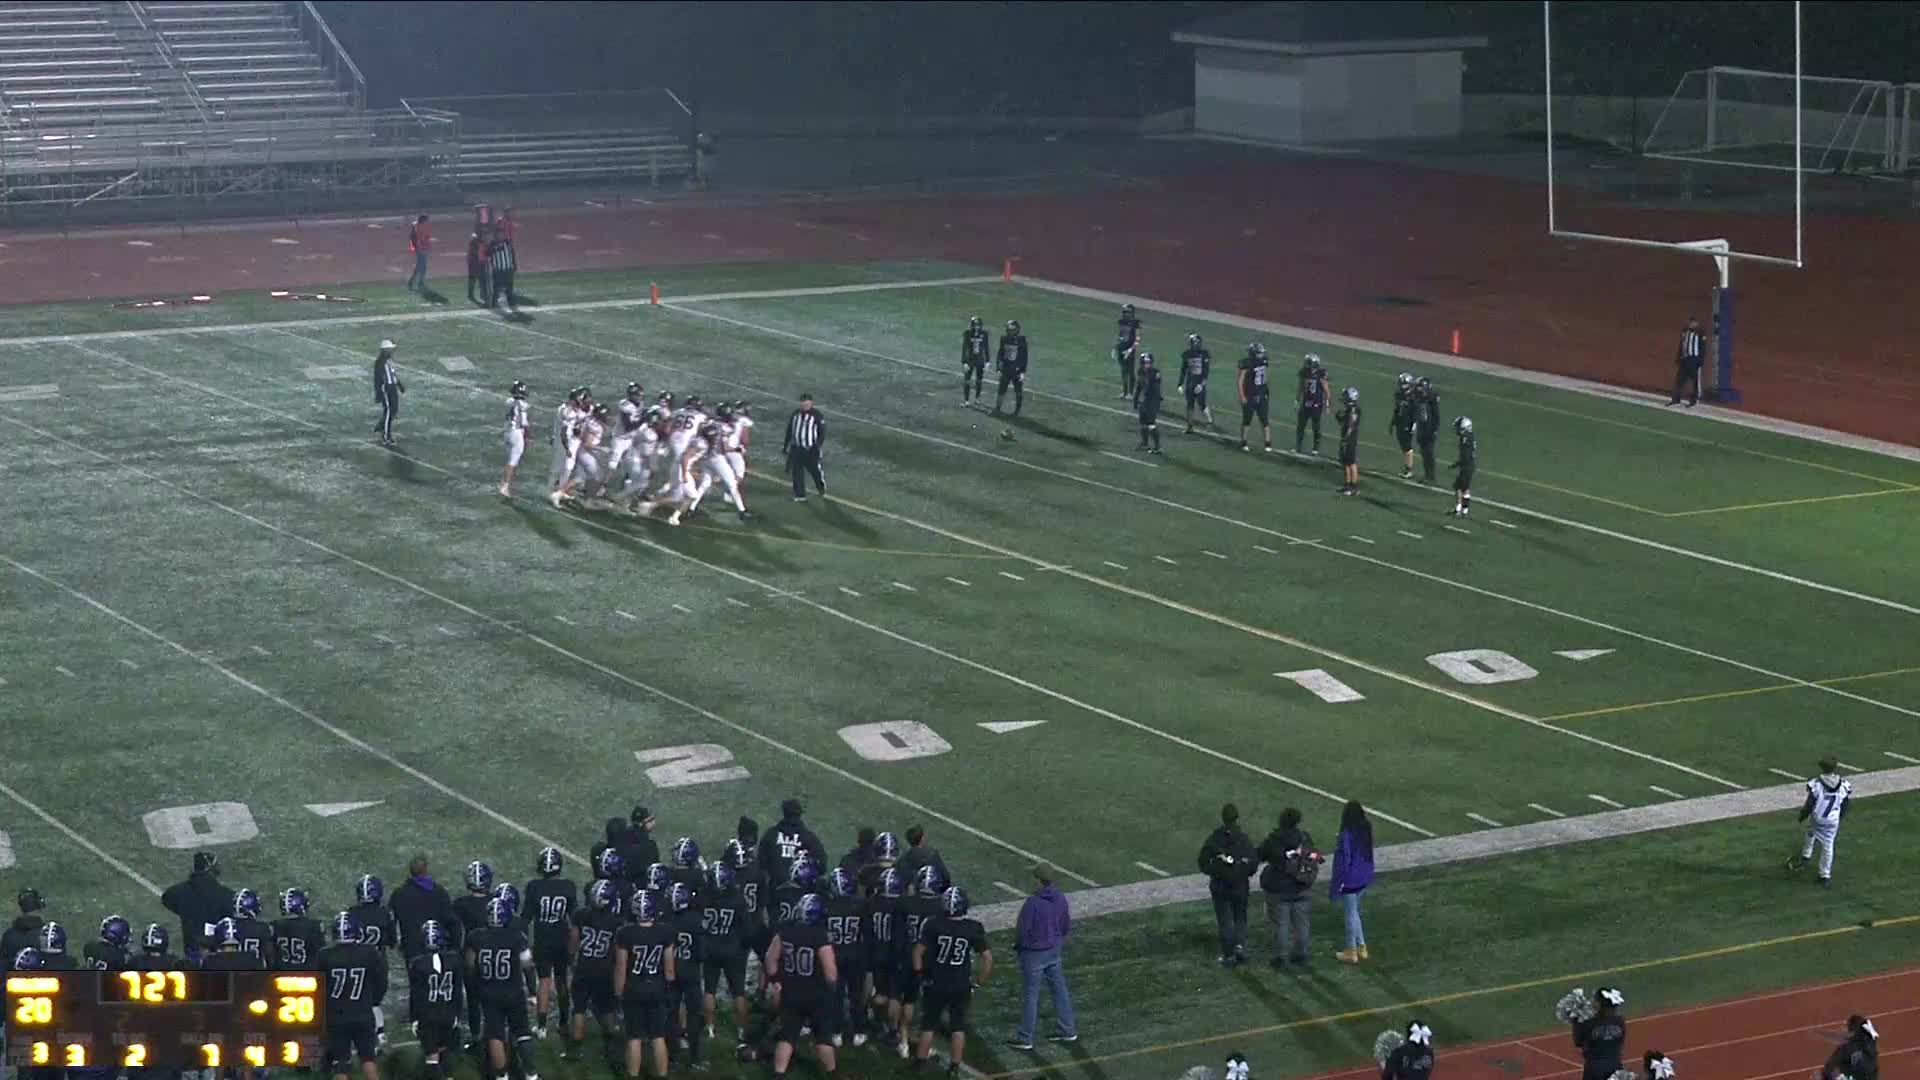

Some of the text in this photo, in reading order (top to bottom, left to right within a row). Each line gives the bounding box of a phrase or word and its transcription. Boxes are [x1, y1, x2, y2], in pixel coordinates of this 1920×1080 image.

[1822, 795, 1838, 819] 7
[776, 832, 802, 847] ALL
[702, 908, 736, 936] 27
[827, 916, 861, 946] 55
[580, 928, 613, 959] 25
[936, 936, 970, 966] 73
[632, 944, 664, 976] 74
[330, 967, 366, 1001] 77
[428, 971, 454, 1003] 14
